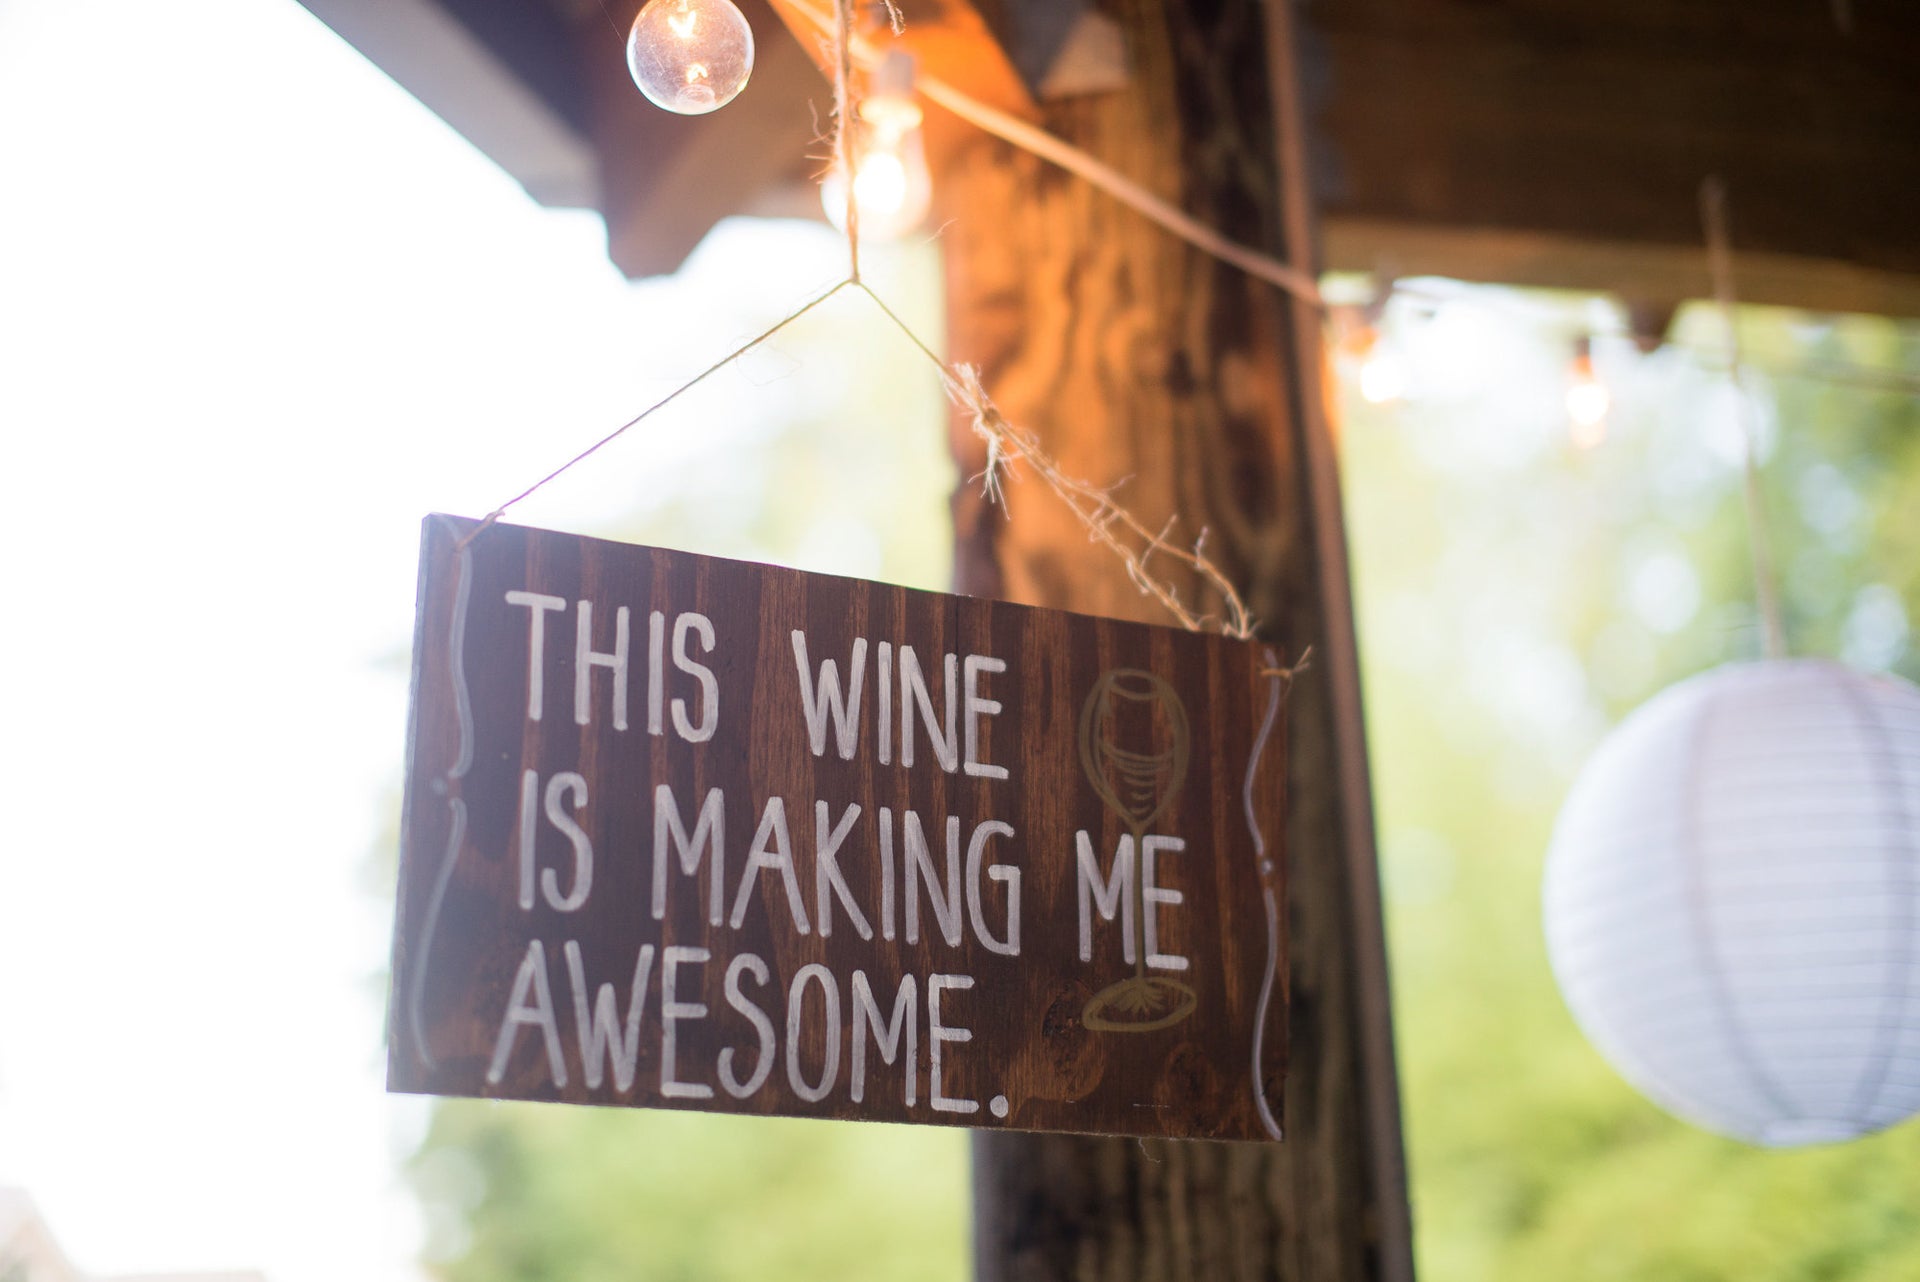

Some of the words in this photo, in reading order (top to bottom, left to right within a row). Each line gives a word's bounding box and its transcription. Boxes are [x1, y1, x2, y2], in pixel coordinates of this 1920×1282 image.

[505, 591, 719, 744] THIS
[790, 628, 1010, 781] WINE
[518, 768, 595, 913] IS
[652, 783, 1022, 957] MAKING
[1075, 830, 1190, 971] ME
[486, 939, 1010, 1118] AWESOME.
